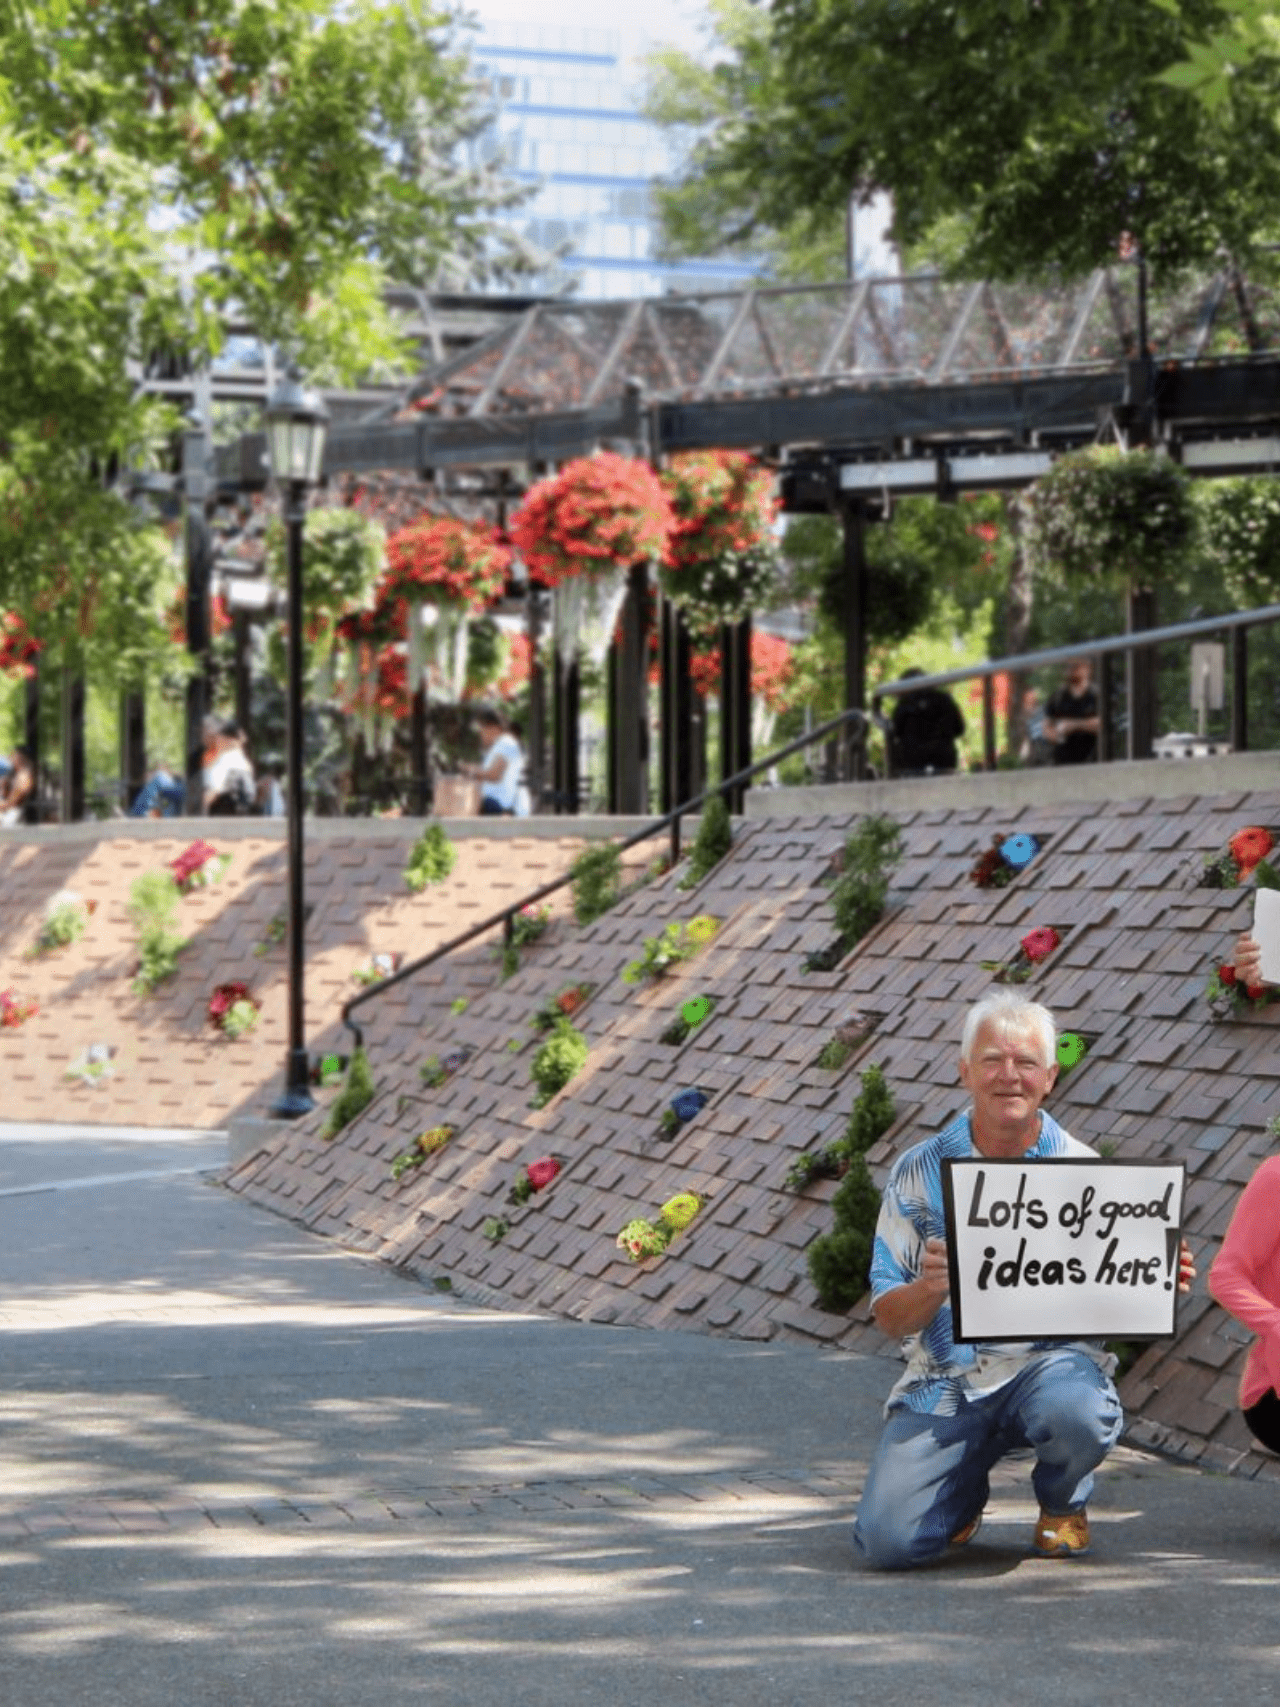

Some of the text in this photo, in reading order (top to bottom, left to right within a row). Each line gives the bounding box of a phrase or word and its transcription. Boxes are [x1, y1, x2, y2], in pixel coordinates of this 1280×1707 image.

[967, 1170, 1175, 1240] Lots of good
[977, 1227, 1180, 1292] ideas here!
